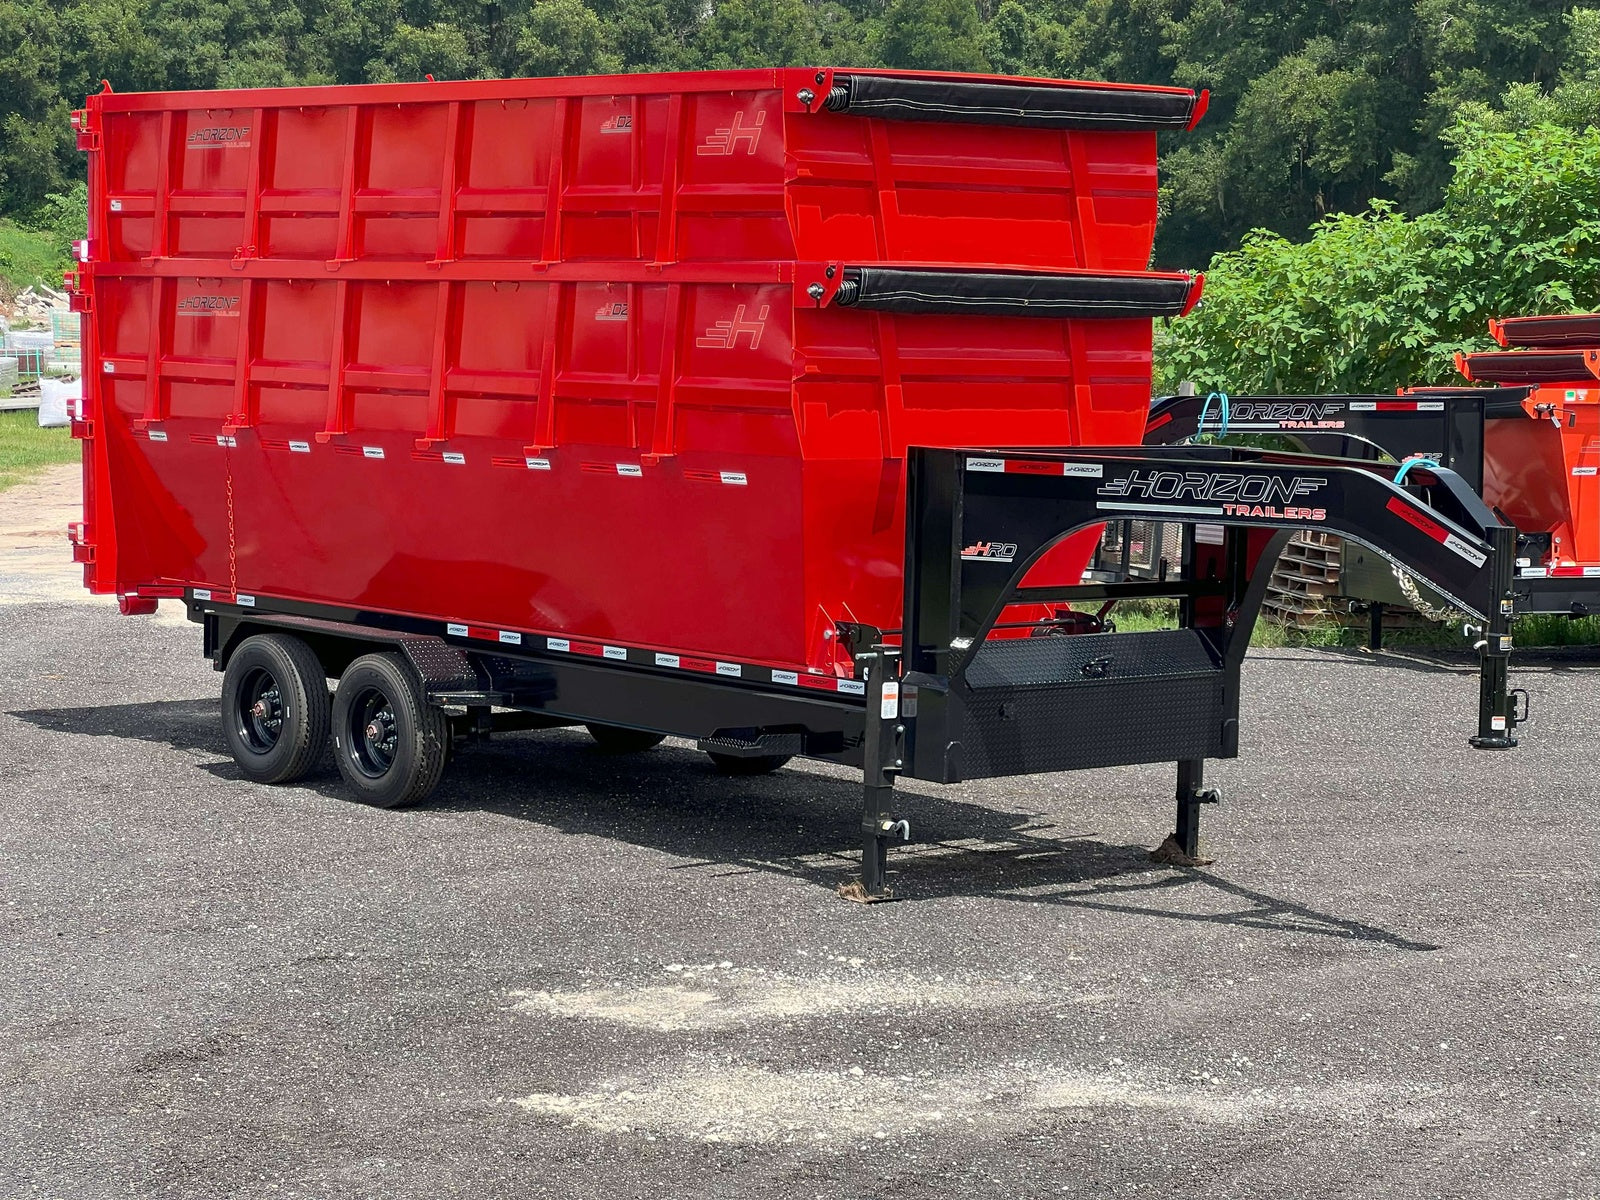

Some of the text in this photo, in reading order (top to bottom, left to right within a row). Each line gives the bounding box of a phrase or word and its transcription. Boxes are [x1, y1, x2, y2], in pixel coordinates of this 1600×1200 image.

[193, 127, 245, 141] HORIZON
[183, 296, 234, 309] HORIZON
[1279, 420, 1345, 429] TRAILERS
[1121, 470, 1303, 503] HORIZON
[1223, 504, 1327, 520] TRAILERS
